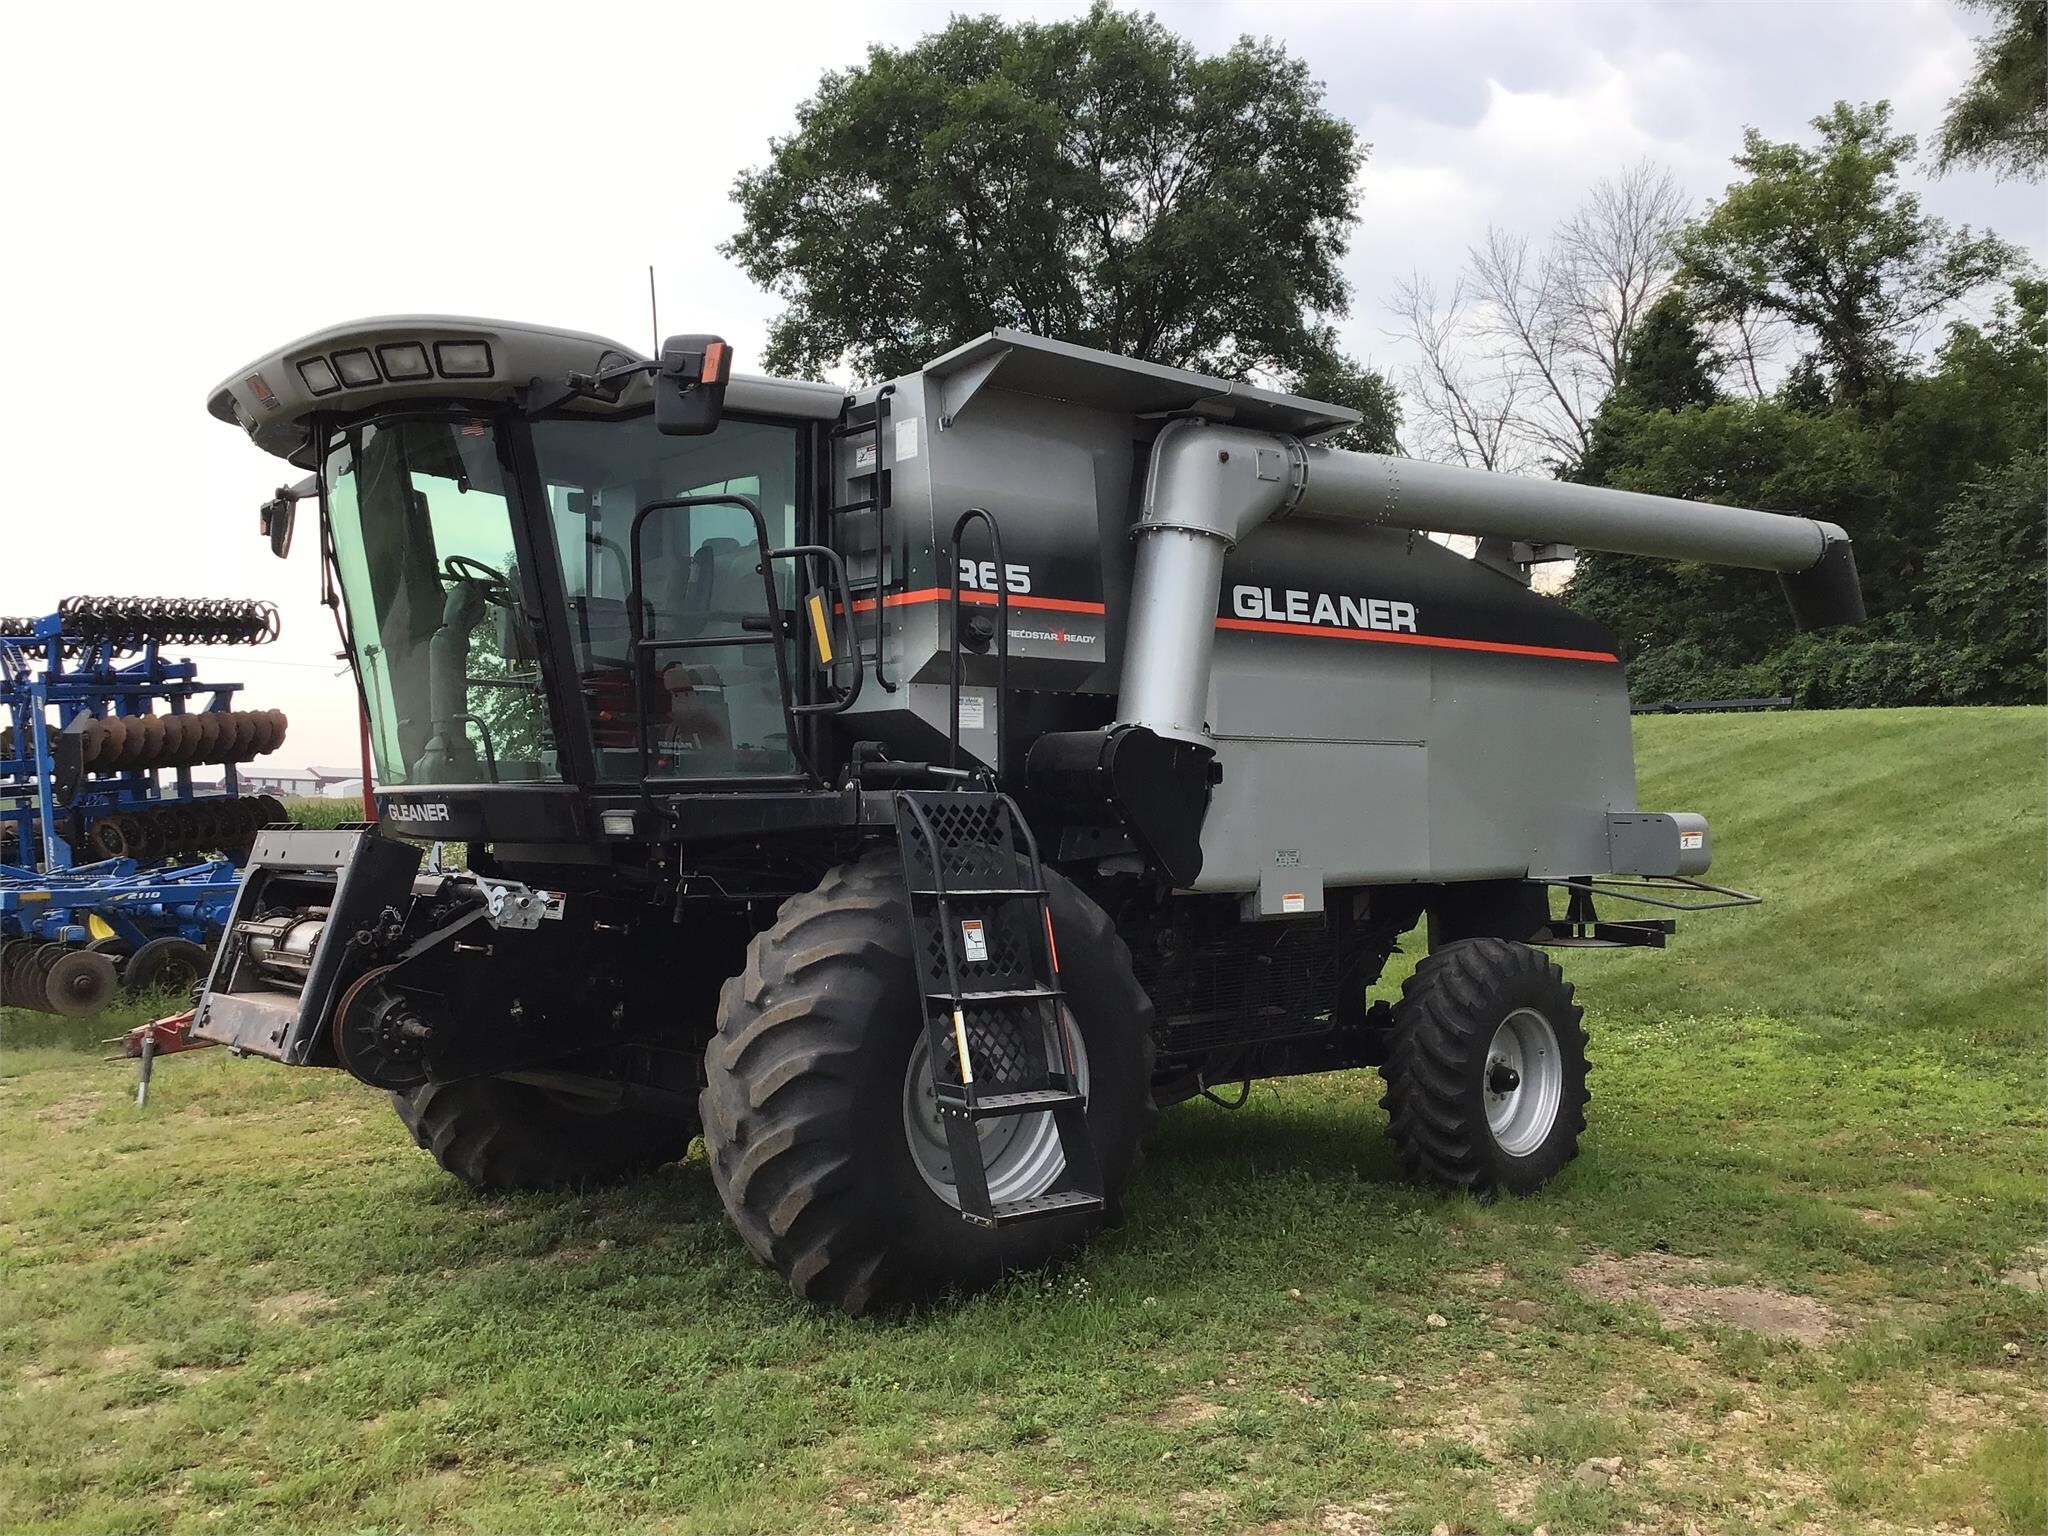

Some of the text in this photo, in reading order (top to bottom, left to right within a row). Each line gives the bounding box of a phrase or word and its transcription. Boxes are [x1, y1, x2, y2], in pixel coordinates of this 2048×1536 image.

[950, 558, 1030, 593] R65
[1232, 584, 1417, 633] GLEANER
[1063, 633, 1096, 644] READY
[388, 803, 449, 821] GLEANER
